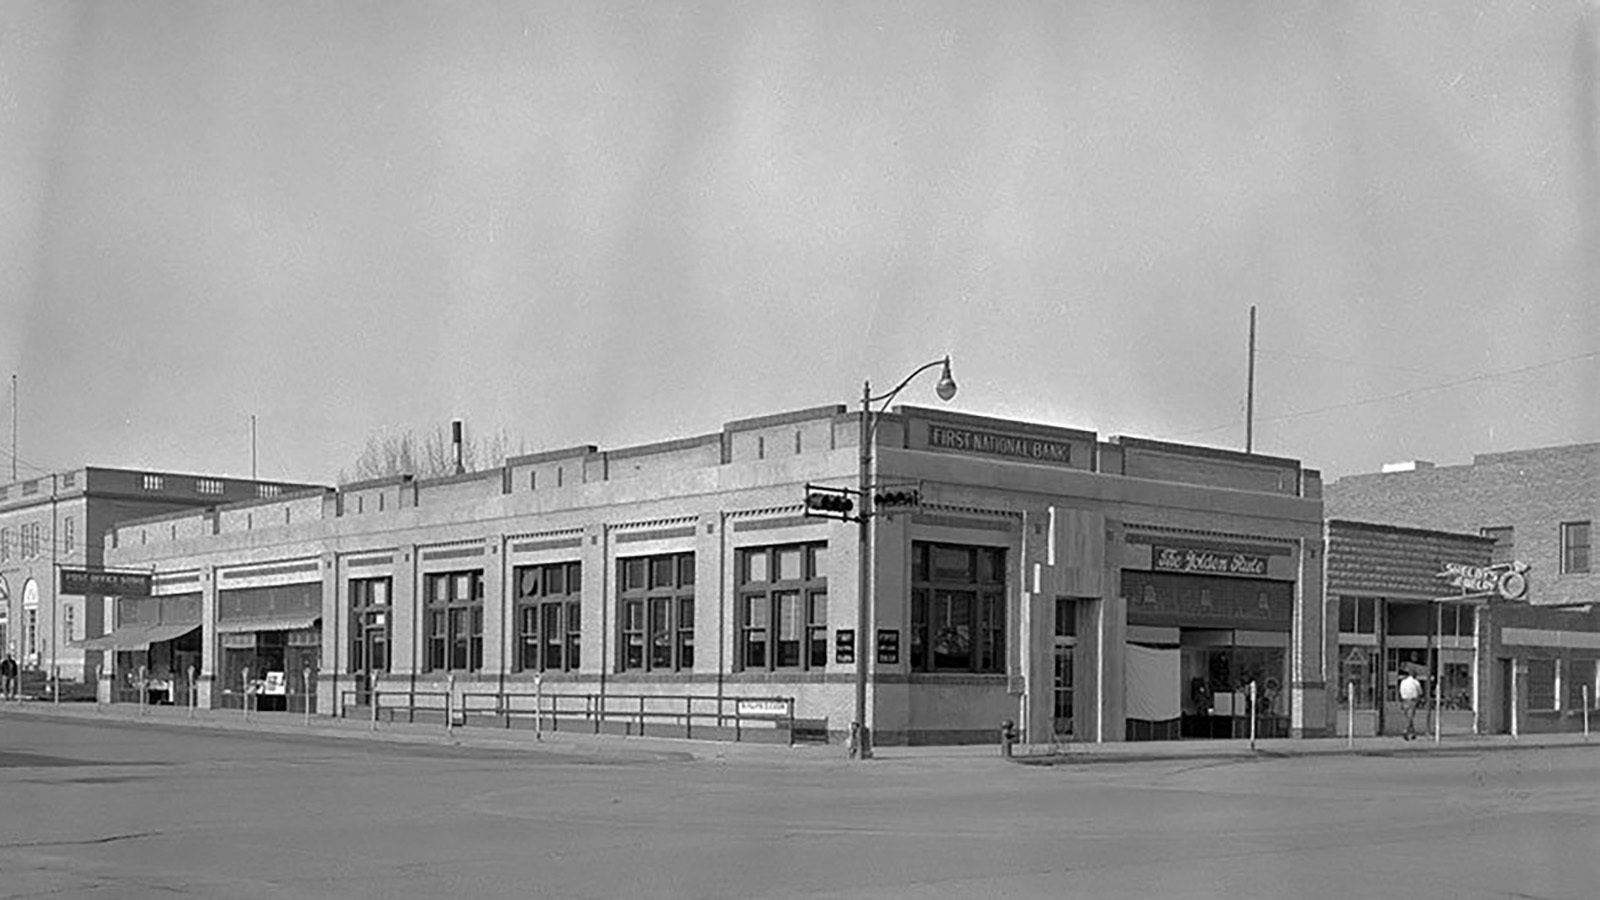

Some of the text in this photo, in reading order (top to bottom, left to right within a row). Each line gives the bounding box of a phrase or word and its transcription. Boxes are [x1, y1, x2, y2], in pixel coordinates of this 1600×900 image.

[933, 427, 1067, 463] FIRST NATIONAL BANK
[1158, 548, 1264, 574] The Golden Rule
[65, 573, 88, 583] POST
[90, 574, 117, 585] OFFICE
